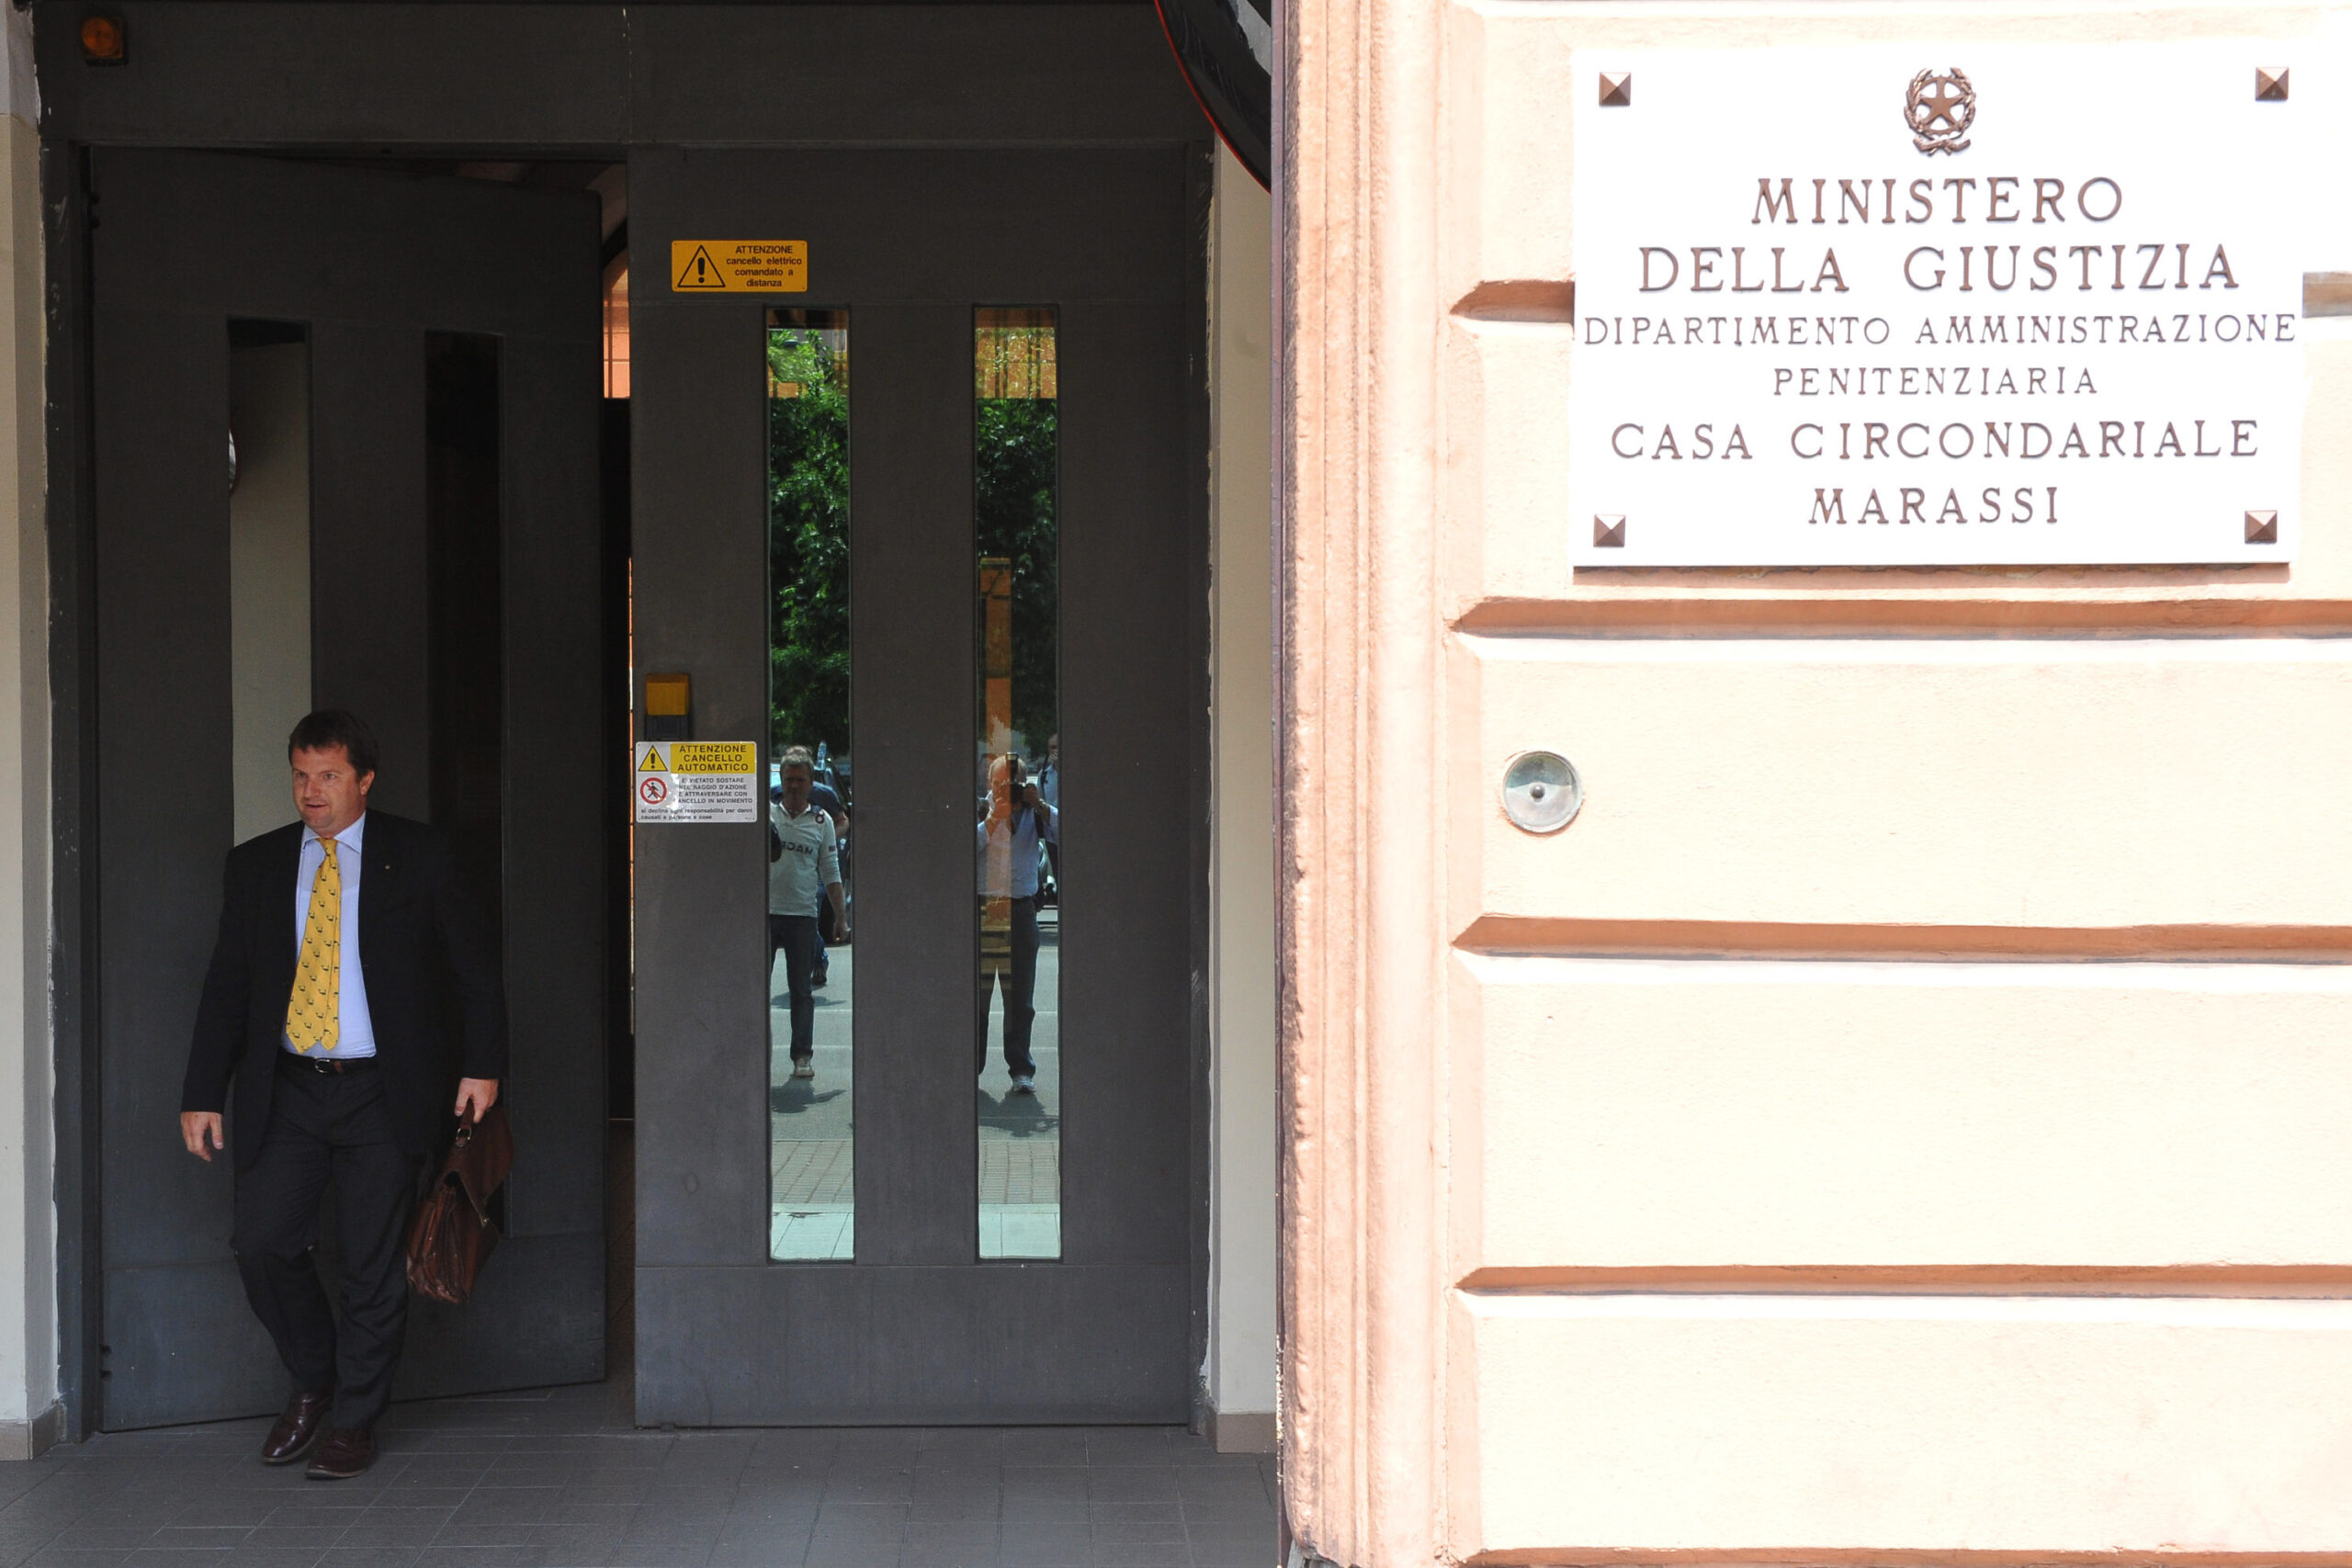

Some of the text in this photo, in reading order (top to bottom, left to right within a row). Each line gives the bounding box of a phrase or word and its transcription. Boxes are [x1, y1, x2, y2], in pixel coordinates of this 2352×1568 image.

[1751, 177, 2124, 224] MINISTERO
[735, 245, 793, 254] ATTENZIONE
[766, 256, 802, 265] elettrico
[1639, 243, 2240, 293] DELLA GIUSTIZIA
[1584, 314, 2296, 347] DIPARTIMENTO AMMINISTRAZIONE
[1773, 367, 2098, 396] PENITENZIARIA
[1611, 420, 2258, 460] CASA CIRCONDARIALE
[1808, 487, 2059, 525] MARASSI
[678, 763, 749, 772] AUTOMATICO
